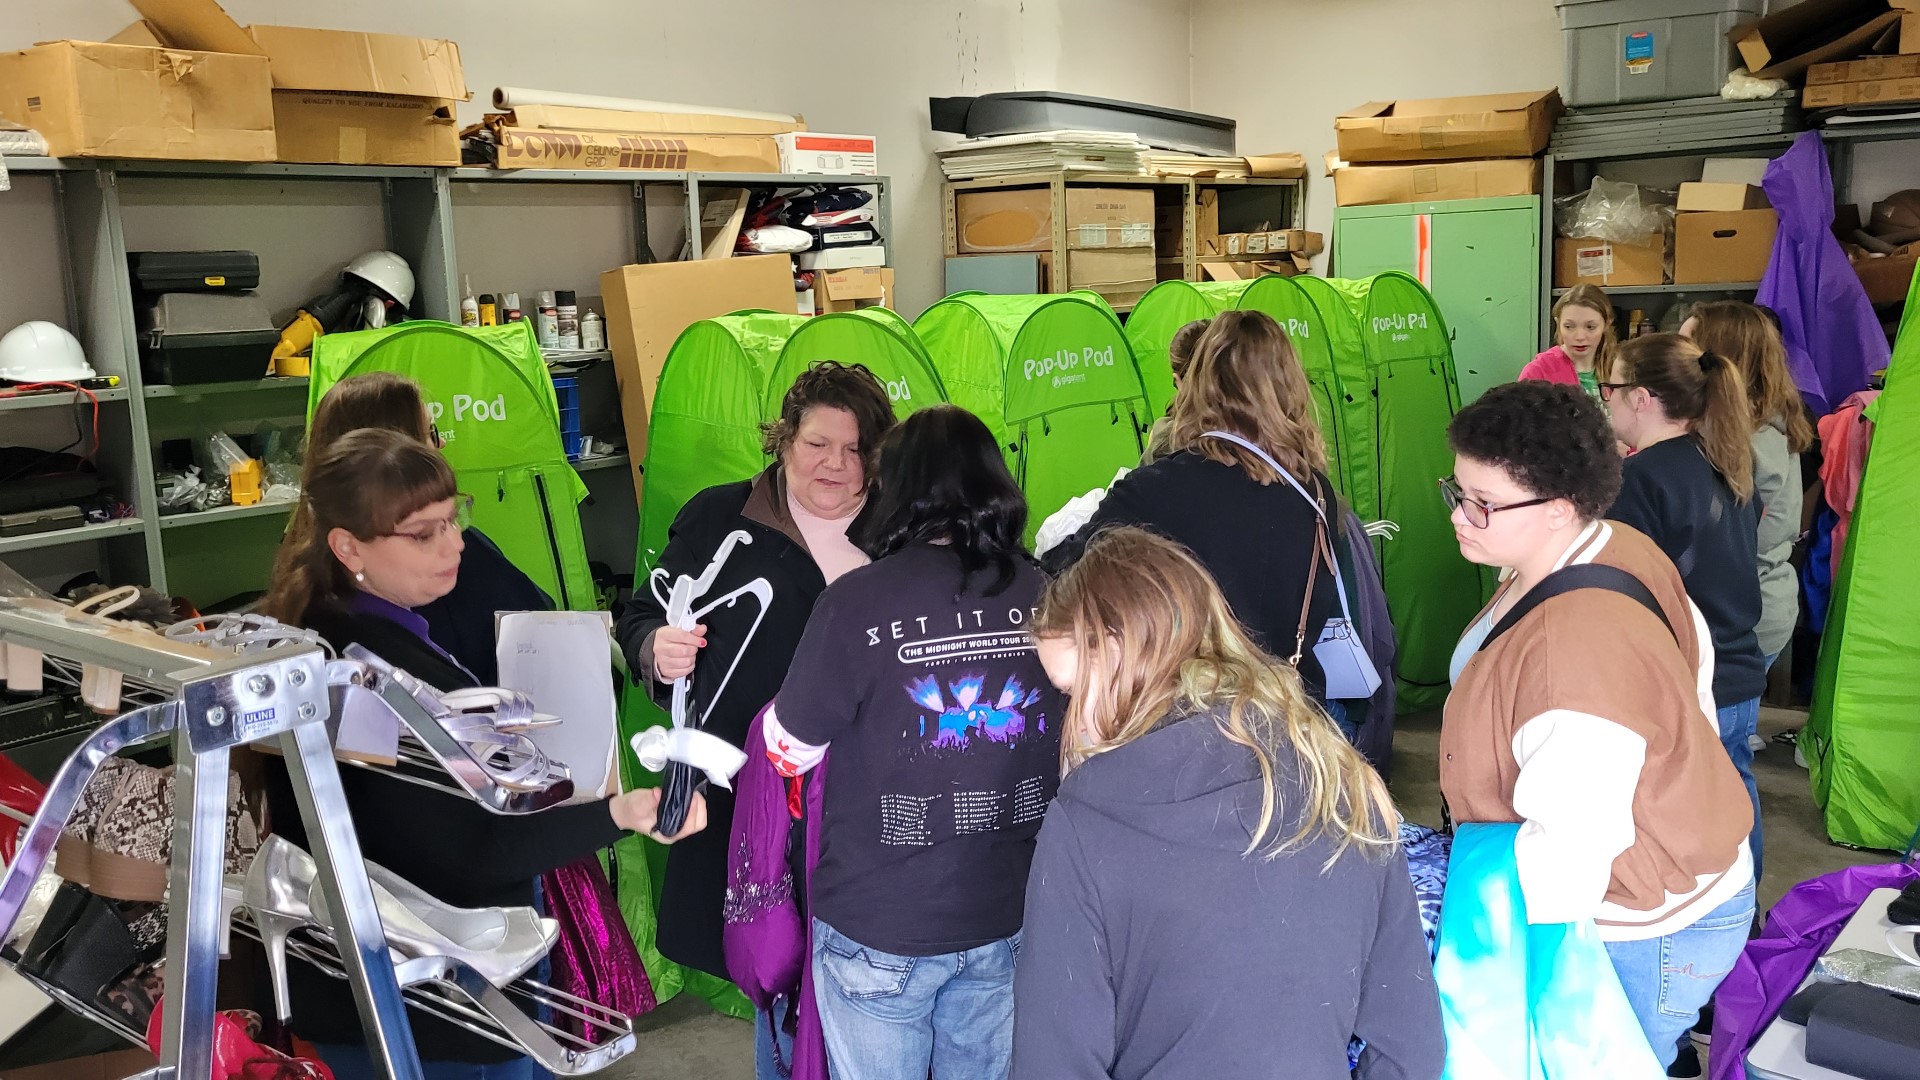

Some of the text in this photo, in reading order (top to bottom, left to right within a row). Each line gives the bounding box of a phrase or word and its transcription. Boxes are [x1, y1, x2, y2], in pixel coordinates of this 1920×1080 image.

[585, 145, 620, 156] CEILING
[585, 157, 607, 167] GRID
[1082, 345, 1114, 368] Pod
[886, 375, 912, 402] od
[453, 393, 507, 422] Pod
[955, 610, 984, 629] IT
[1008, 607, 1039, 625] OF
[904, 646, 923, 657] THE
[925, 641, 967, 654] MIDNIGHT
[968, 637, 998, 649] WORLD
[1000, 636, 1021, 646] TOUR
[246, 709, 274, 724] ULINE
